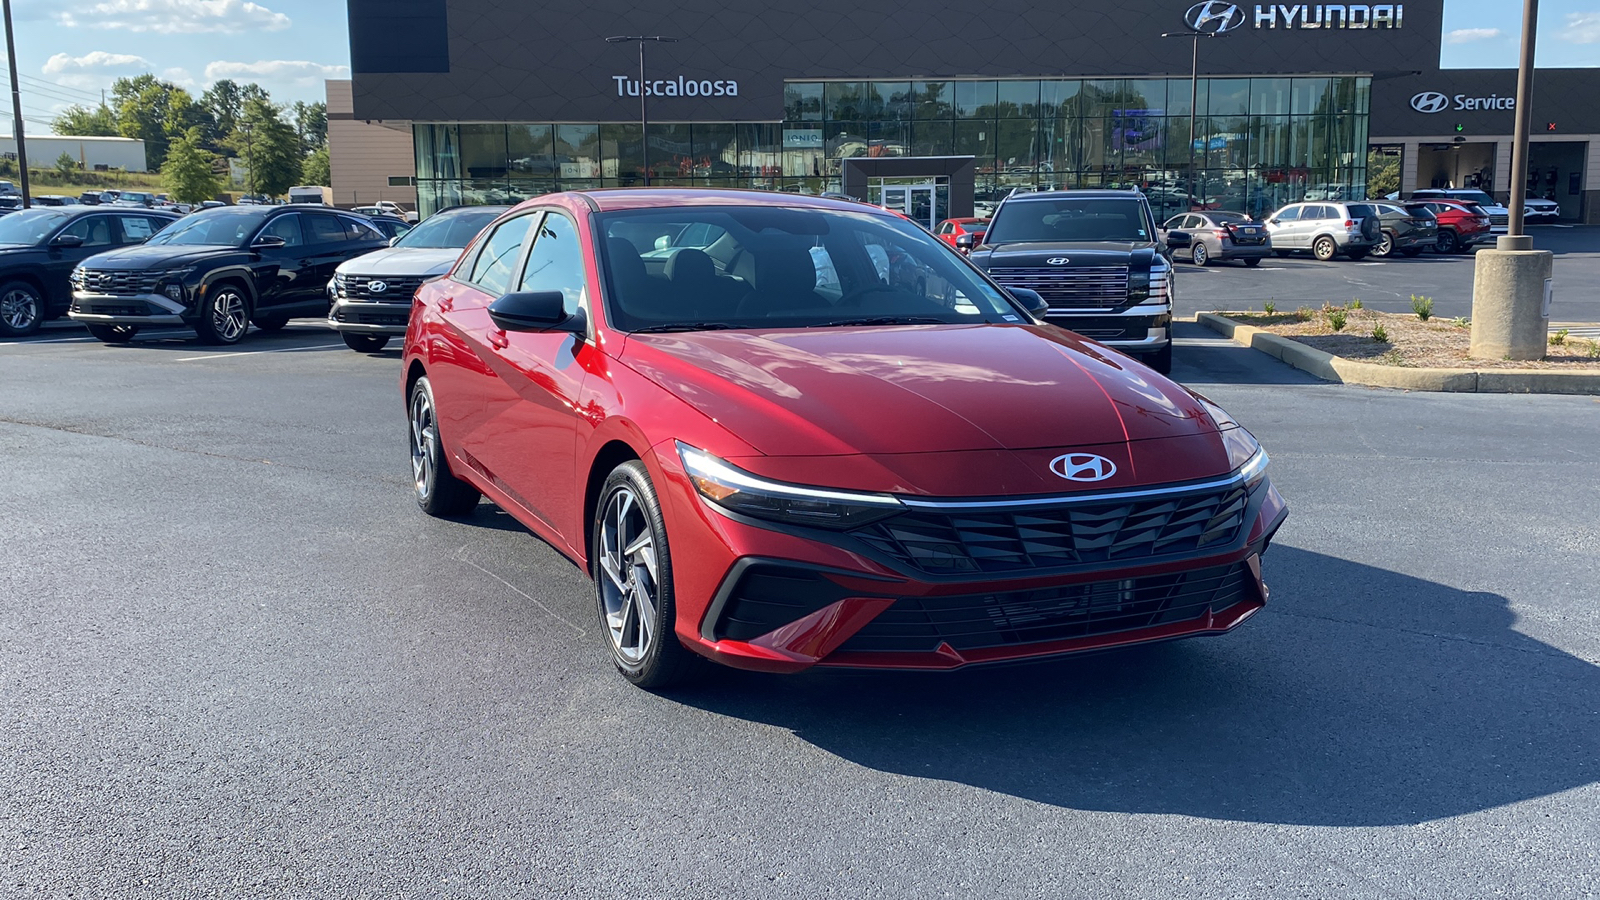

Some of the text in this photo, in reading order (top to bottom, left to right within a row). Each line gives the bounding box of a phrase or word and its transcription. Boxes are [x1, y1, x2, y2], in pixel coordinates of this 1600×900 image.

[1254, 4, 1403, 29] HYUNDAI
[612, 75, 738, 97] Tuscaloosa
[1453, 93, 1515, 111] Service
